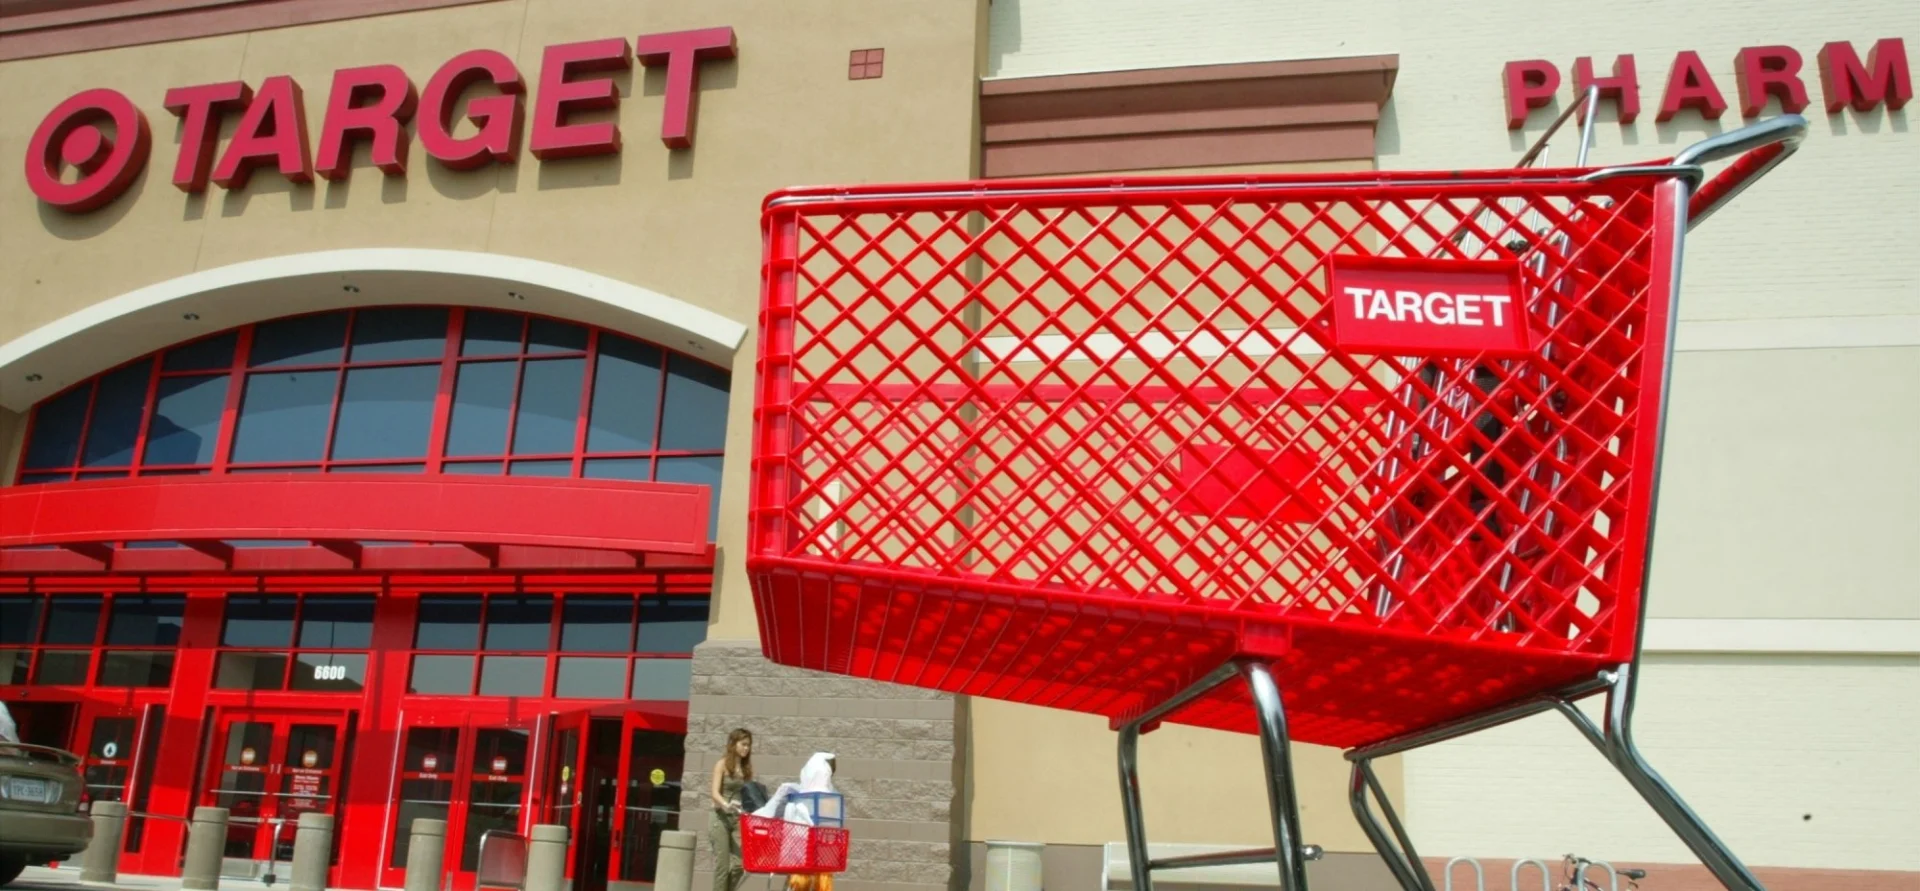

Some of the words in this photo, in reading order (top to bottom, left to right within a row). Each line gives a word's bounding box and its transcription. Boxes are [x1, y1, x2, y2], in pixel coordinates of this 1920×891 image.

[163, 26, 738, 193] TARGET
[1501, 37, 1913, 130] PHARM
[1343, 286, 1511, 327] TARGET
[313, 665, 346, 680] 6600
